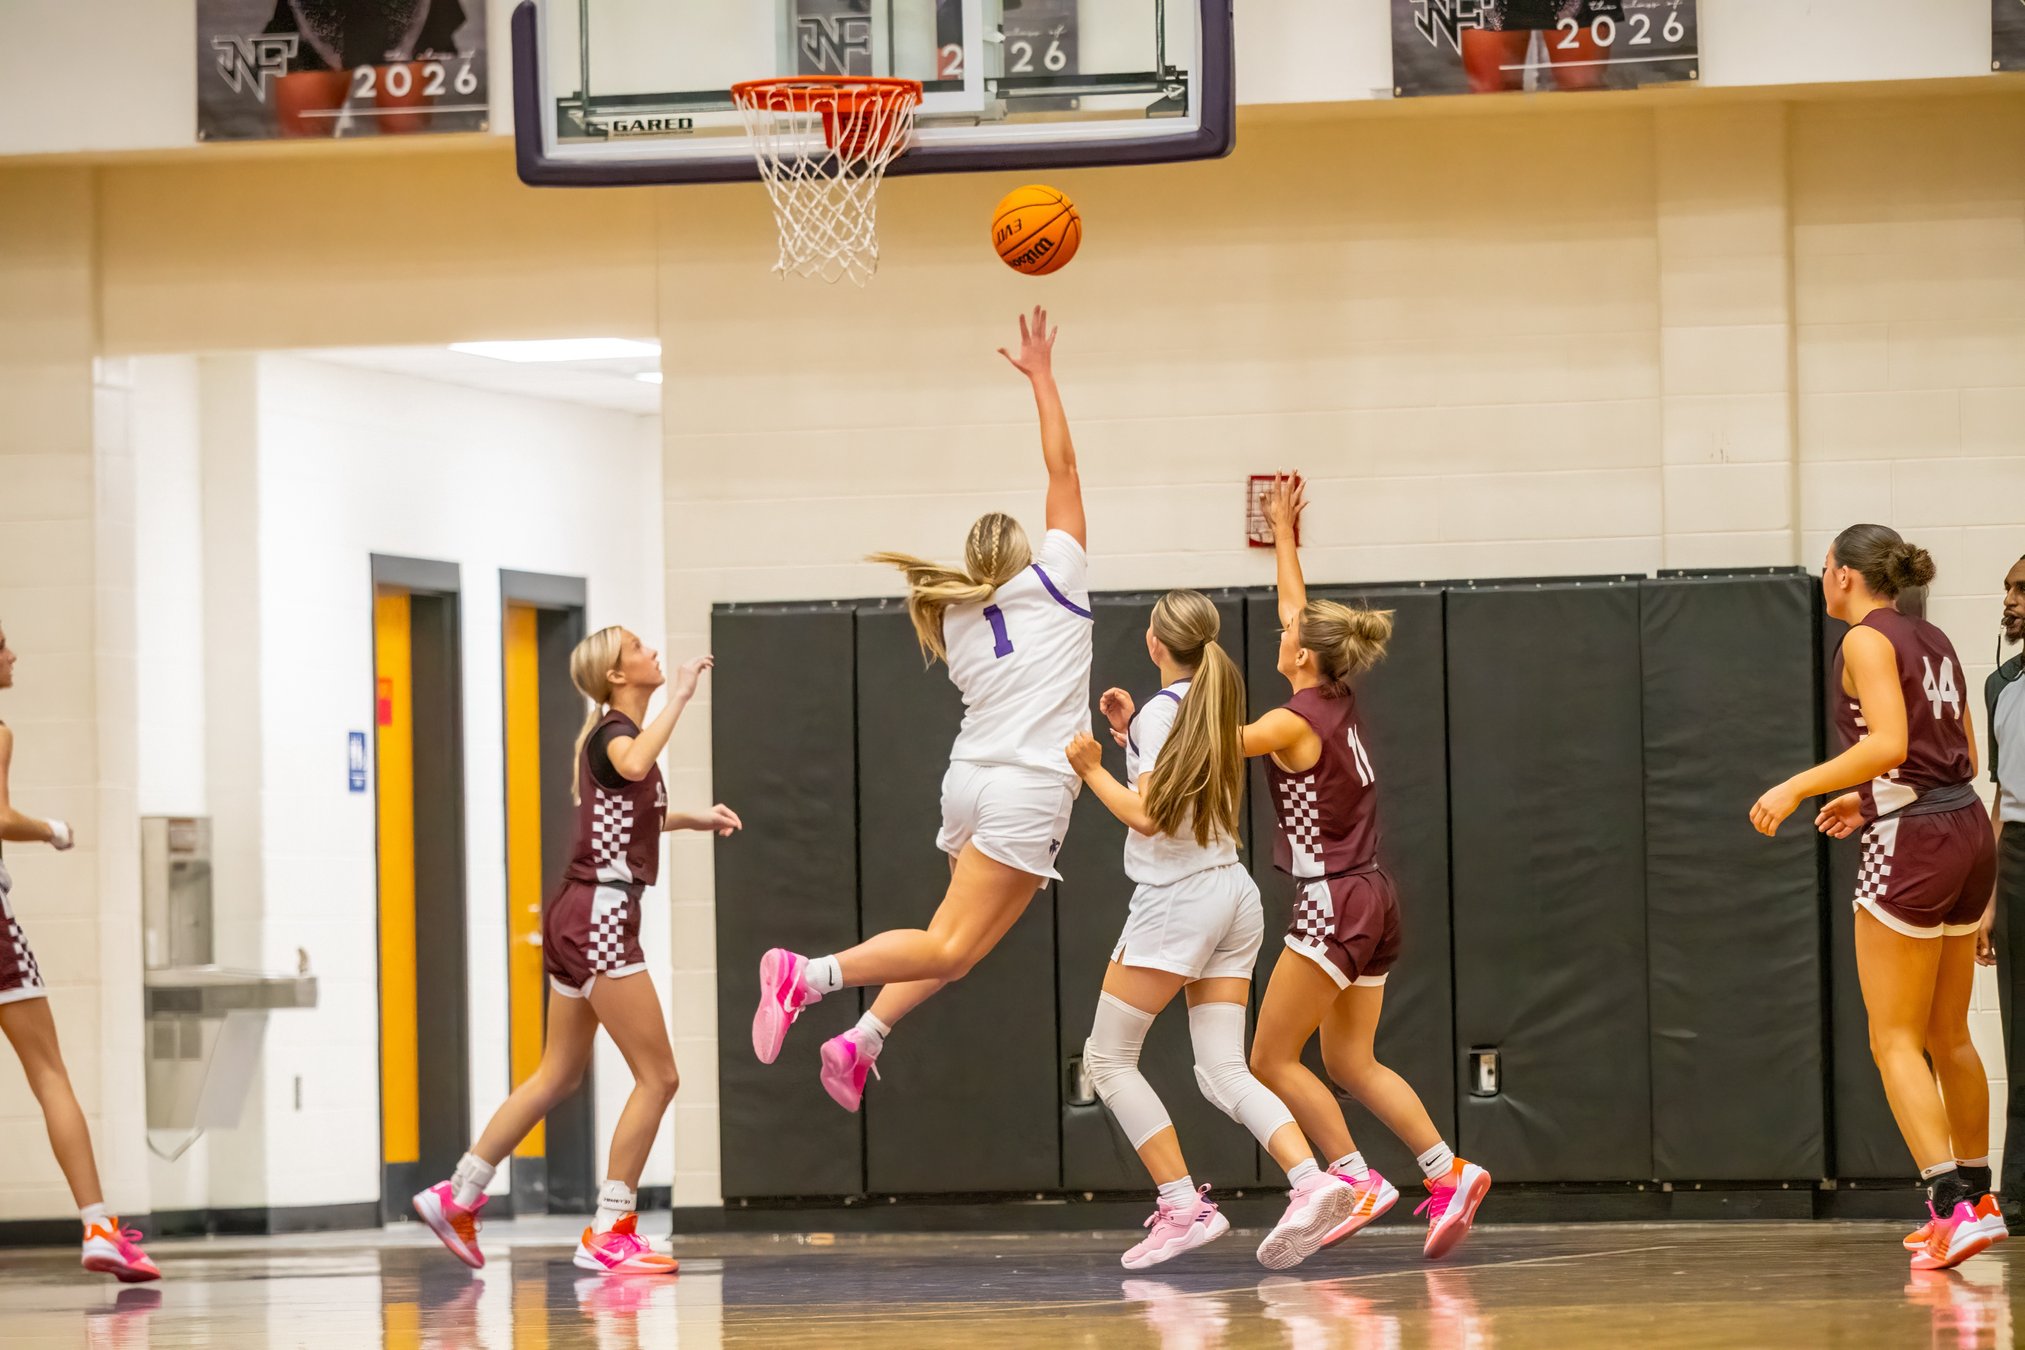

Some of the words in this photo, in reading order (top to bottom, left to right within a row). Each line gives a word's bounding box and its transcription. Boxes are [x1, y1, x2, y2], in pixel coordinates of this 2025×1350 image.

[1556, 11, 1685, 50] 2026
[353, 62, 478, 98] 2026
[613, 118, 693, 132] GARED
[983, 603, 1014, 659] 1
[1922, 656, 1960, 720] 44
